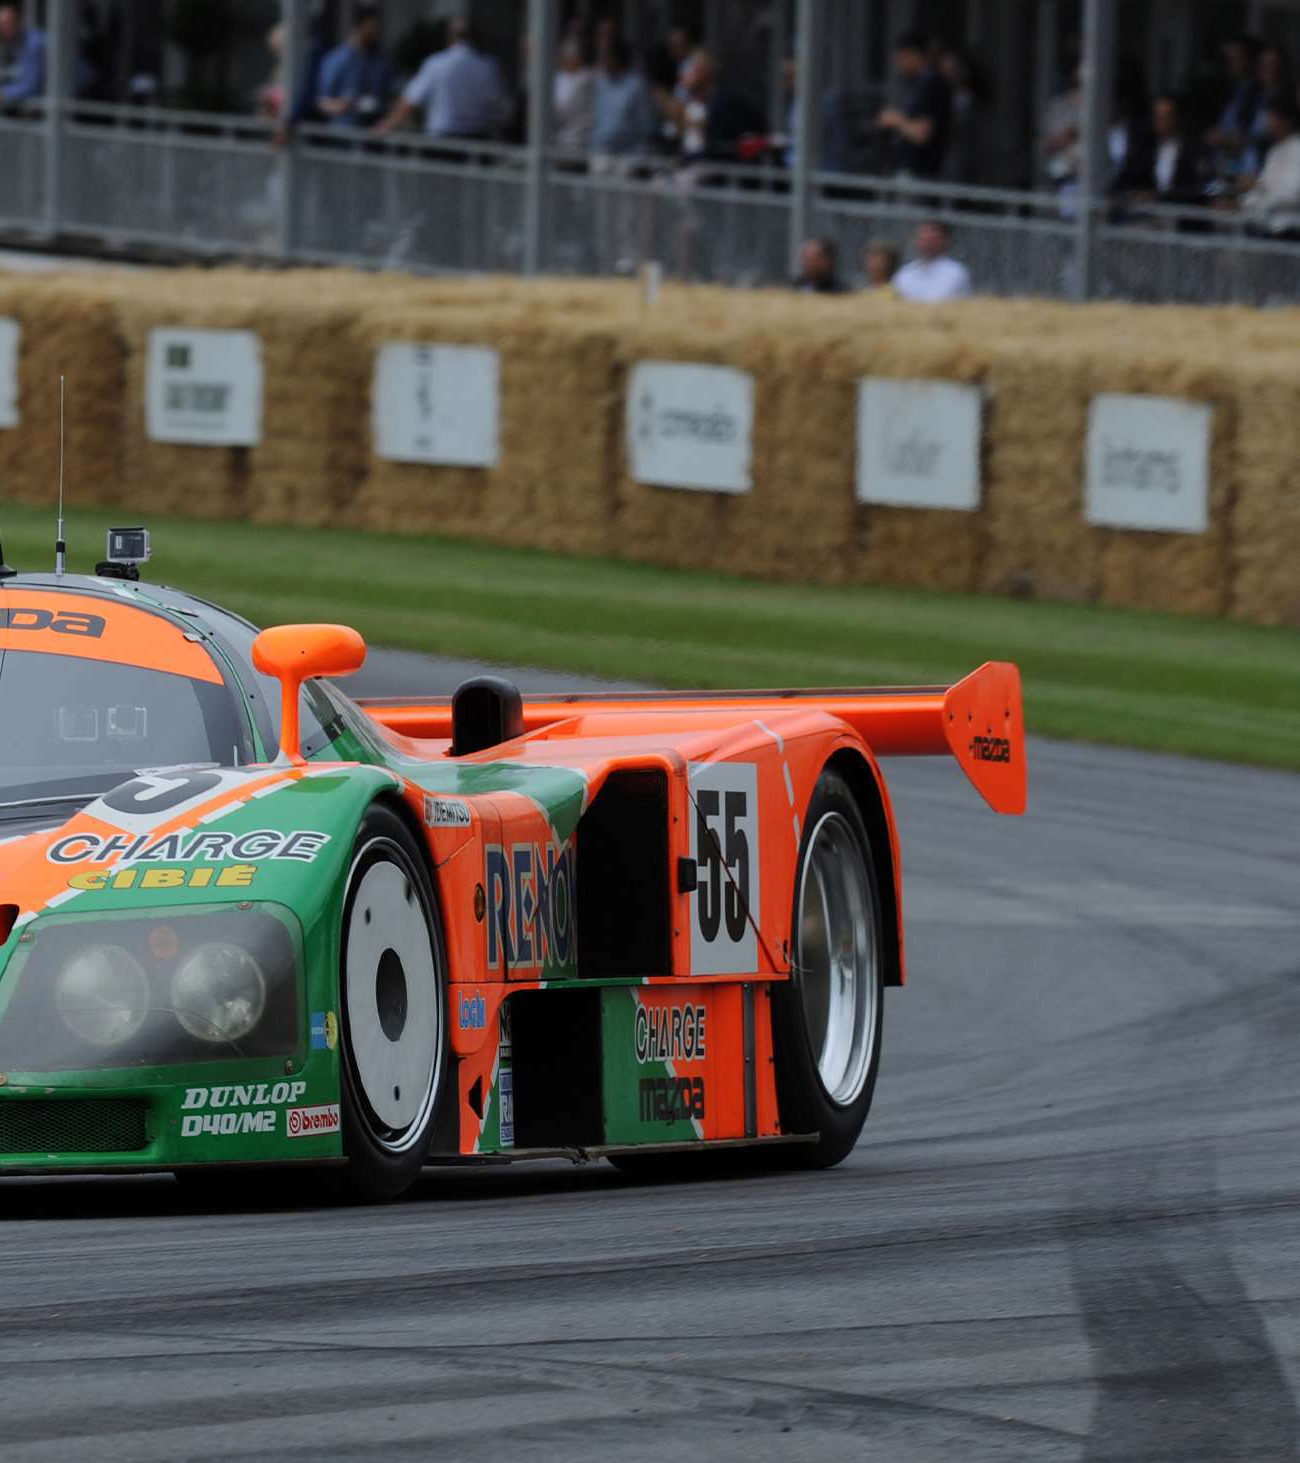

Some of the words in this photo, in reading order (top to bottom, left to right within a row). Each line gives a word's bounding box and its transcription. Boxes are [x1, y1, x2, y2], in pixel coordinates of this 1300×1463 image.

[46, 830, 331, 864] CHARGE
[68, 864, 258, 890] CIBIÉ
[696, 790, 749, 943] 55
[485, 842, 577, 968] RENO
[635, 1002, 705, 1064] CHARGE
[181, 1080, 306, 1109] DUNLOP
[181, 1110, 277, 1137] D40/M2
[302, 1107, 339, 1130] brembo
